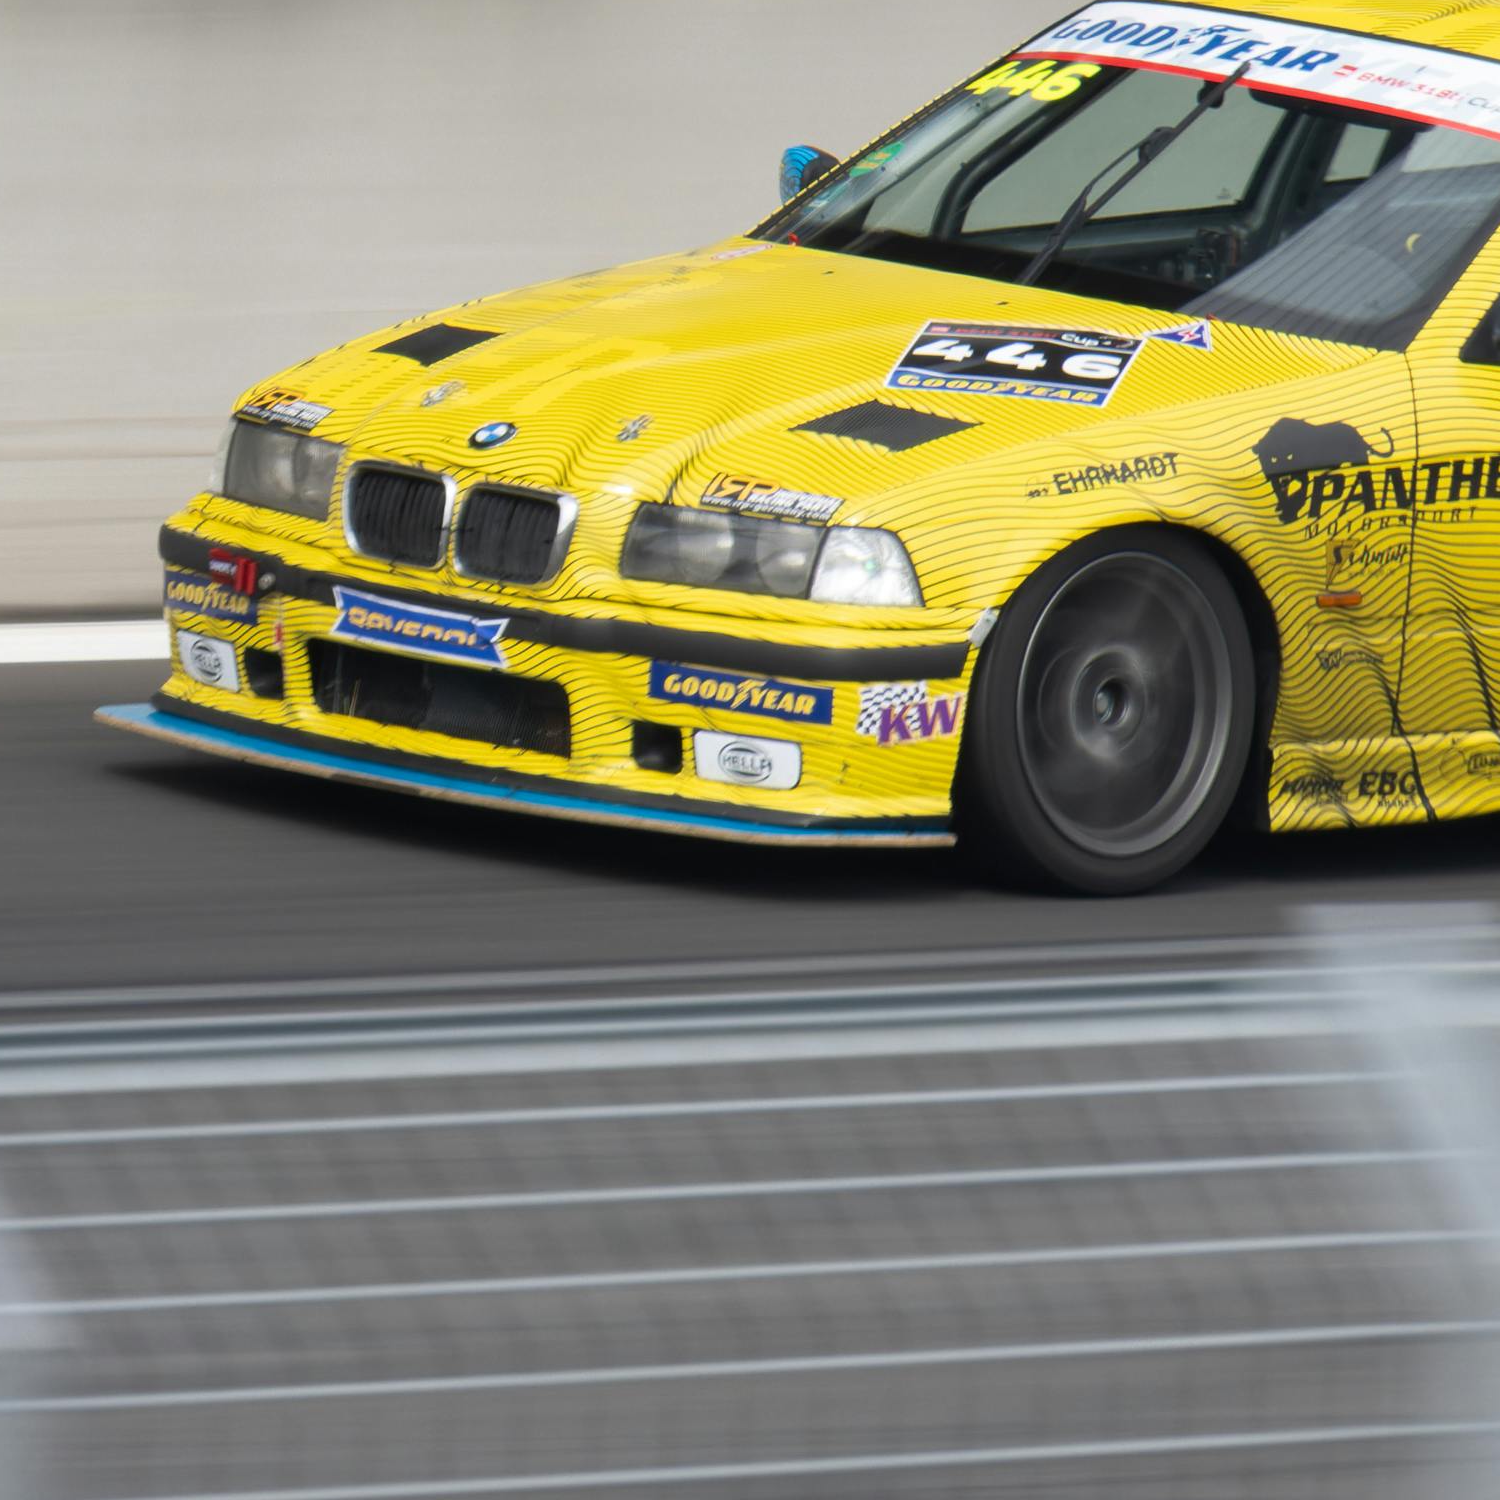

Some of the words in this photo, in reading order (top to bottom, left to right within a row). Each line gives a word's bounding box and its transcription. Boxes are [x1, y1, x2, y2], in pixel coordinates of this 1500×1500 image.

[1051, 16, 1340, 73] GOODYEAR
[965, 59, 1102, 102] 446
[1356, 72, 1411, 90] BMW
[912, 338, 1123, 380] 446
[1060, 332, 1100, 348] Cup
[897, 373, 1099, 403] GOODYEAR
[1052, 452, 1179, 495] EHRHARDT
[166, 580, 250, 615] GOODYEAR
[662, 672, 817, 715] GOODYEAR
[875, 694, 964, 747] KW
[1359, 771, 1418, 796] EBC
